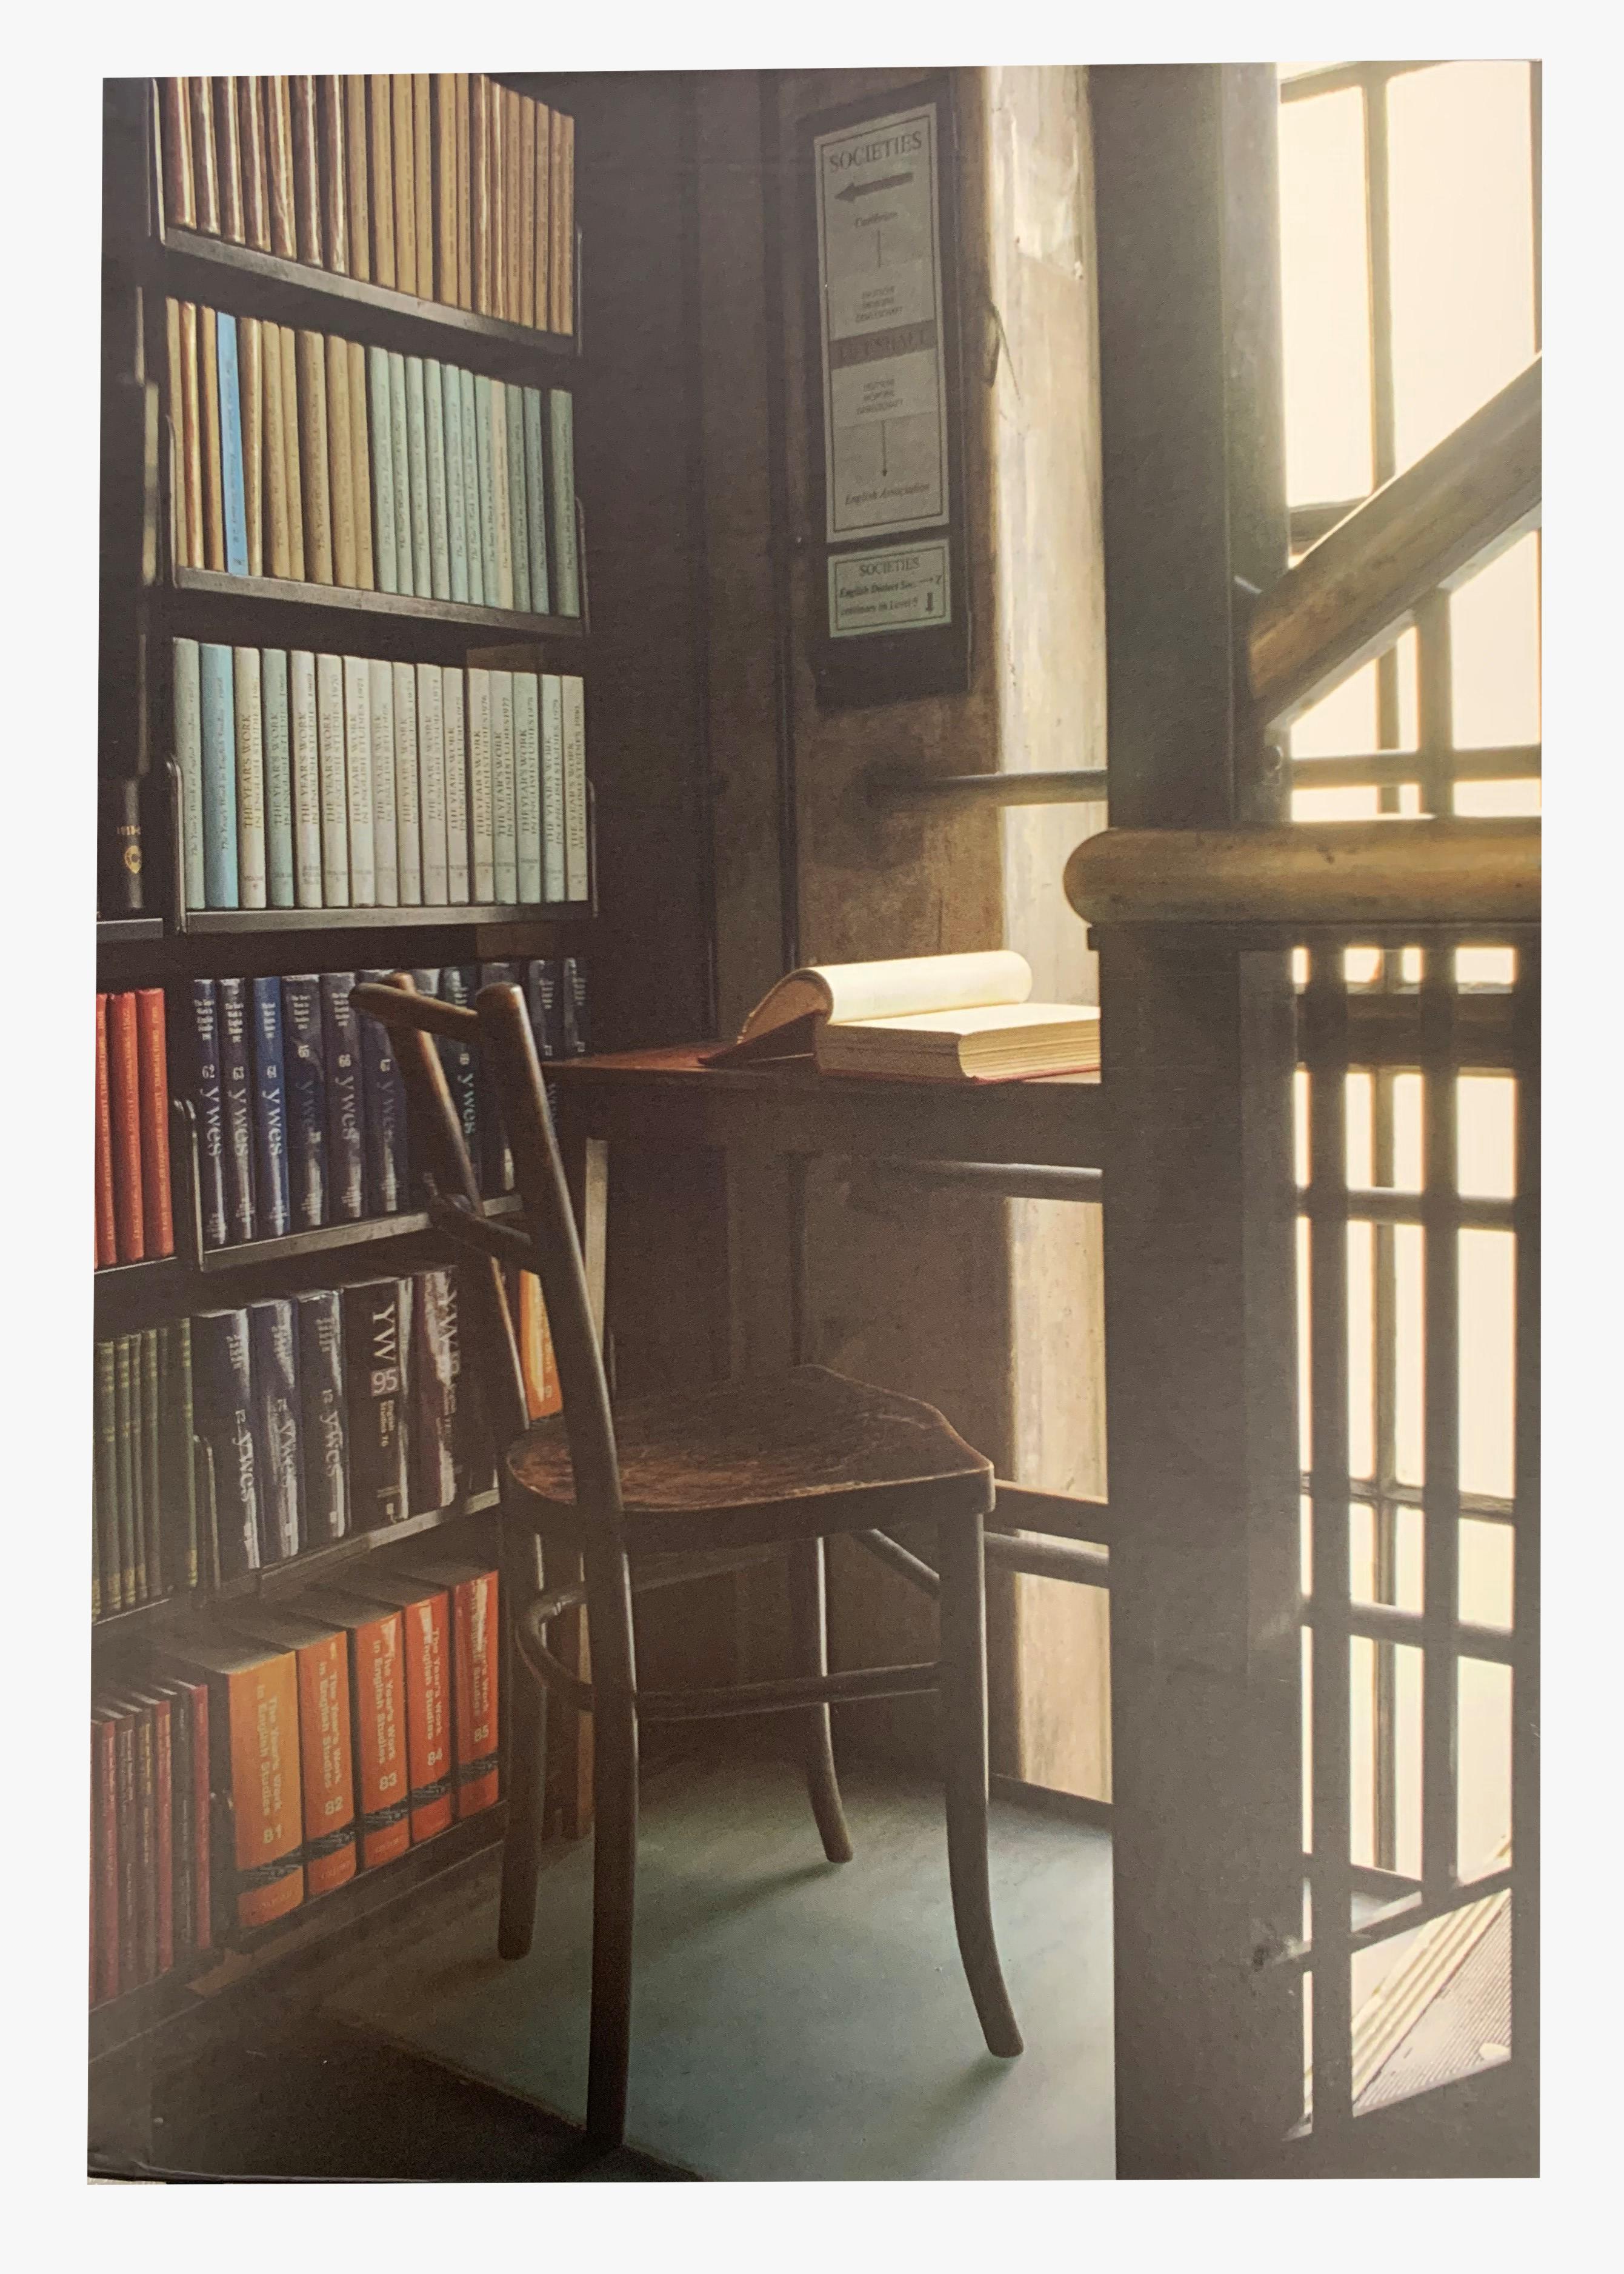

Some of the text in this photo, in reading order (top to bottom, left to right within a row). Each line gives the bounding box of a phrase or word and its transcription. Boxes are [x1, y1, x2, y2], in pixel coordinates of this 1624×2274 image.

[830, 130, 922, 172] SOCIETIES
[859, 556, 920, 576] SOCIETIES
[242, 716, 251, 754] WORK
[270, 713, 279, 752] WORK
[299, 712, 307, 751] WORK
[322, 713, 331, 752] WORK
[348, 715, 358, 753] WORK
[373, 715, 382, 752] WORK
[399, 718, 408, 755] WORK
[243, 805, 253, 829] THE
[273, 801, 282, 825] THE
[301, 801, 310, 825] THE
[325, 801, 335, 825] THE
[352, 802, 361, 825] THE
[376, 801, 385, 822] THE
[402, 803, 411, 822] THE
[427, 800, 436, 822] THE
[476, 813, 484, 835] THE
[497, 816, 506, 836] THE
[373, 1369, 398, 1395] 95
[432, 1628, 441, 1655] The
[373, 1639, 387, 1764] in English Studies
[319, 1661, 332, 1789] in English Studies
[435, 1701, 444, 1736] Work
[387, 1724, 397, 1759] Work
[474, 1723, 489, 1742] 85
[257, 1684, 271, 1816] in English Studies
[268, 1696, 278, 1723] The
[273, 1773, 282, 1811] Work
[427, 1747, 443, 1766] 84
[334, 1747, 342, 1785] Work
[379, 1771, 398, 1792] 83
[324, 1795, 344, 1815] 82
[263, 1822, 283, 1844] 81
